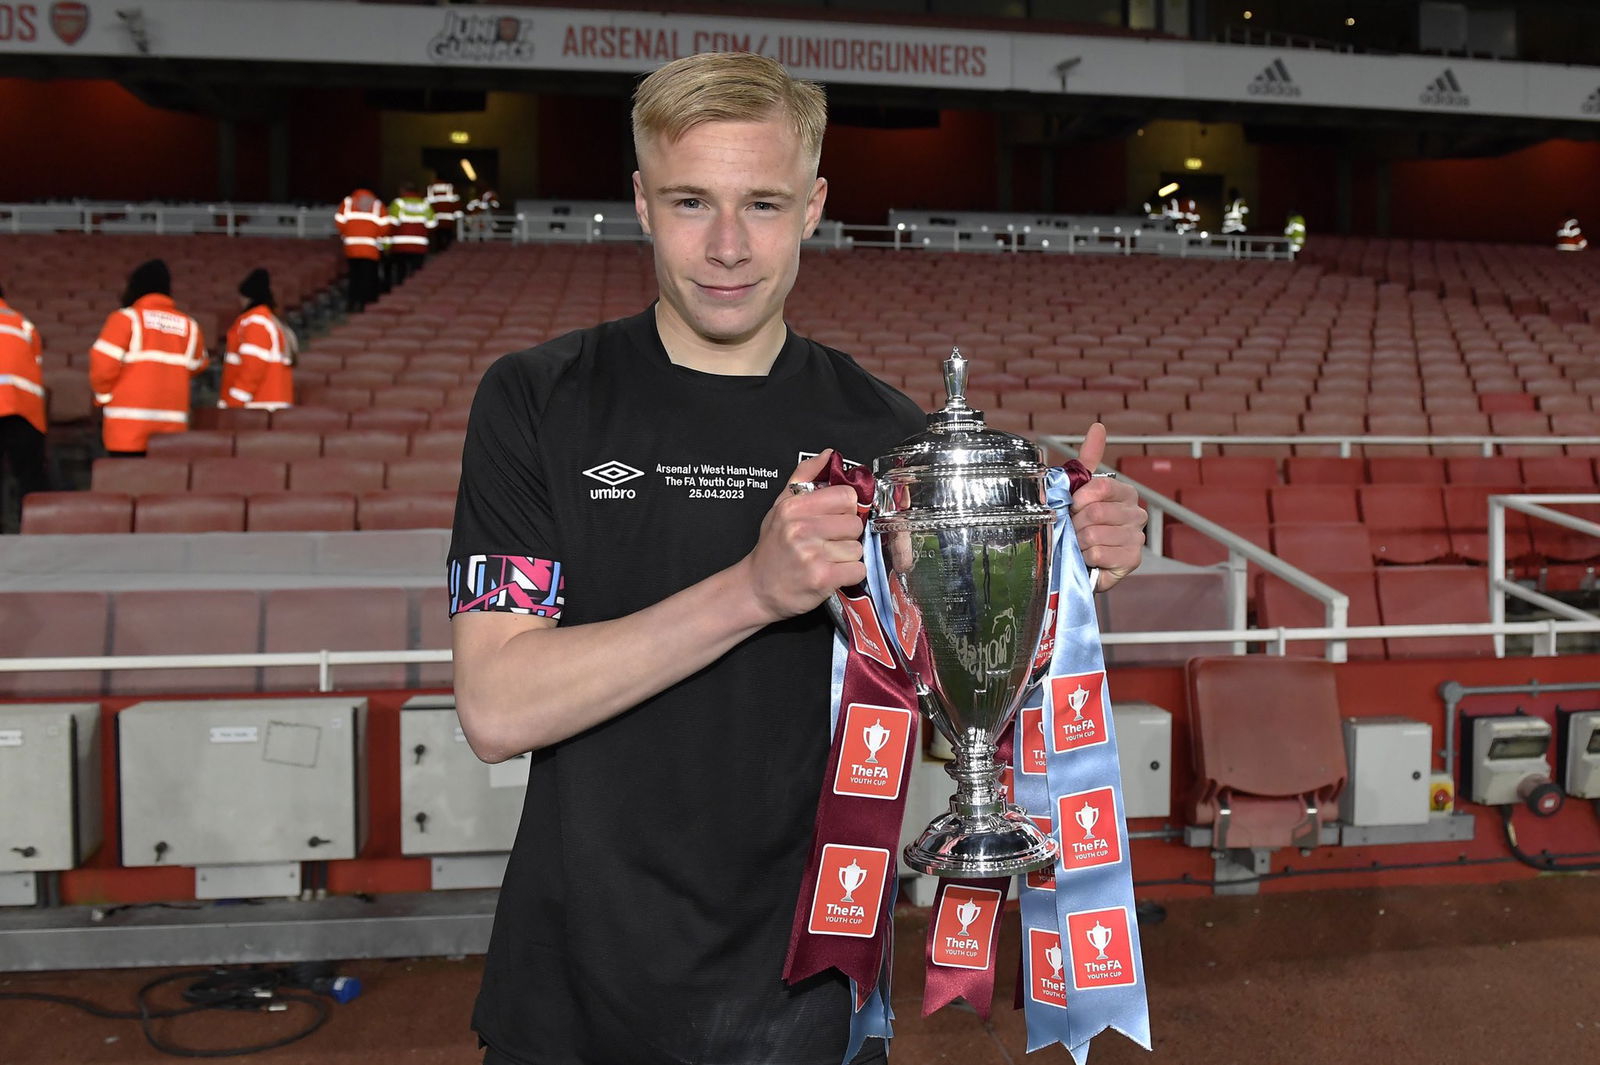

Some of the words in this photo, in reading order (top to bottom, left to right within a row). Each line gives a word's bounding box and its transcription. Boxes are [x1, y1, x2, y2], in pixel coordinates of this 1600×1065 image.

[656, 463, 691, 475] Arsenal
[693, 466, 699, 475] v
[700, 464, 725, 475] West
[727, 466, 748, 476] Ham
[749, 466, 779, 478] United
[665, 476, 683, 487] The
[684, 477, 696, 487] FA
[698, 477, 725, 487] Youth
[726, 478, 745, 489] Cup
[746, 478, 769, 489] Final
[590, 486, 636, 500] umbro
[688, 489, 745, 499] 25.04.2023
[1065, 732, 1083, 741] YOUTH
[1084, 730, 1095, 738] CUP
[850, 776, 872, 785] YOUTH
[1075, 852, 1096, 860] YOUTH
[825, 916, 848, 924] YOUTH
